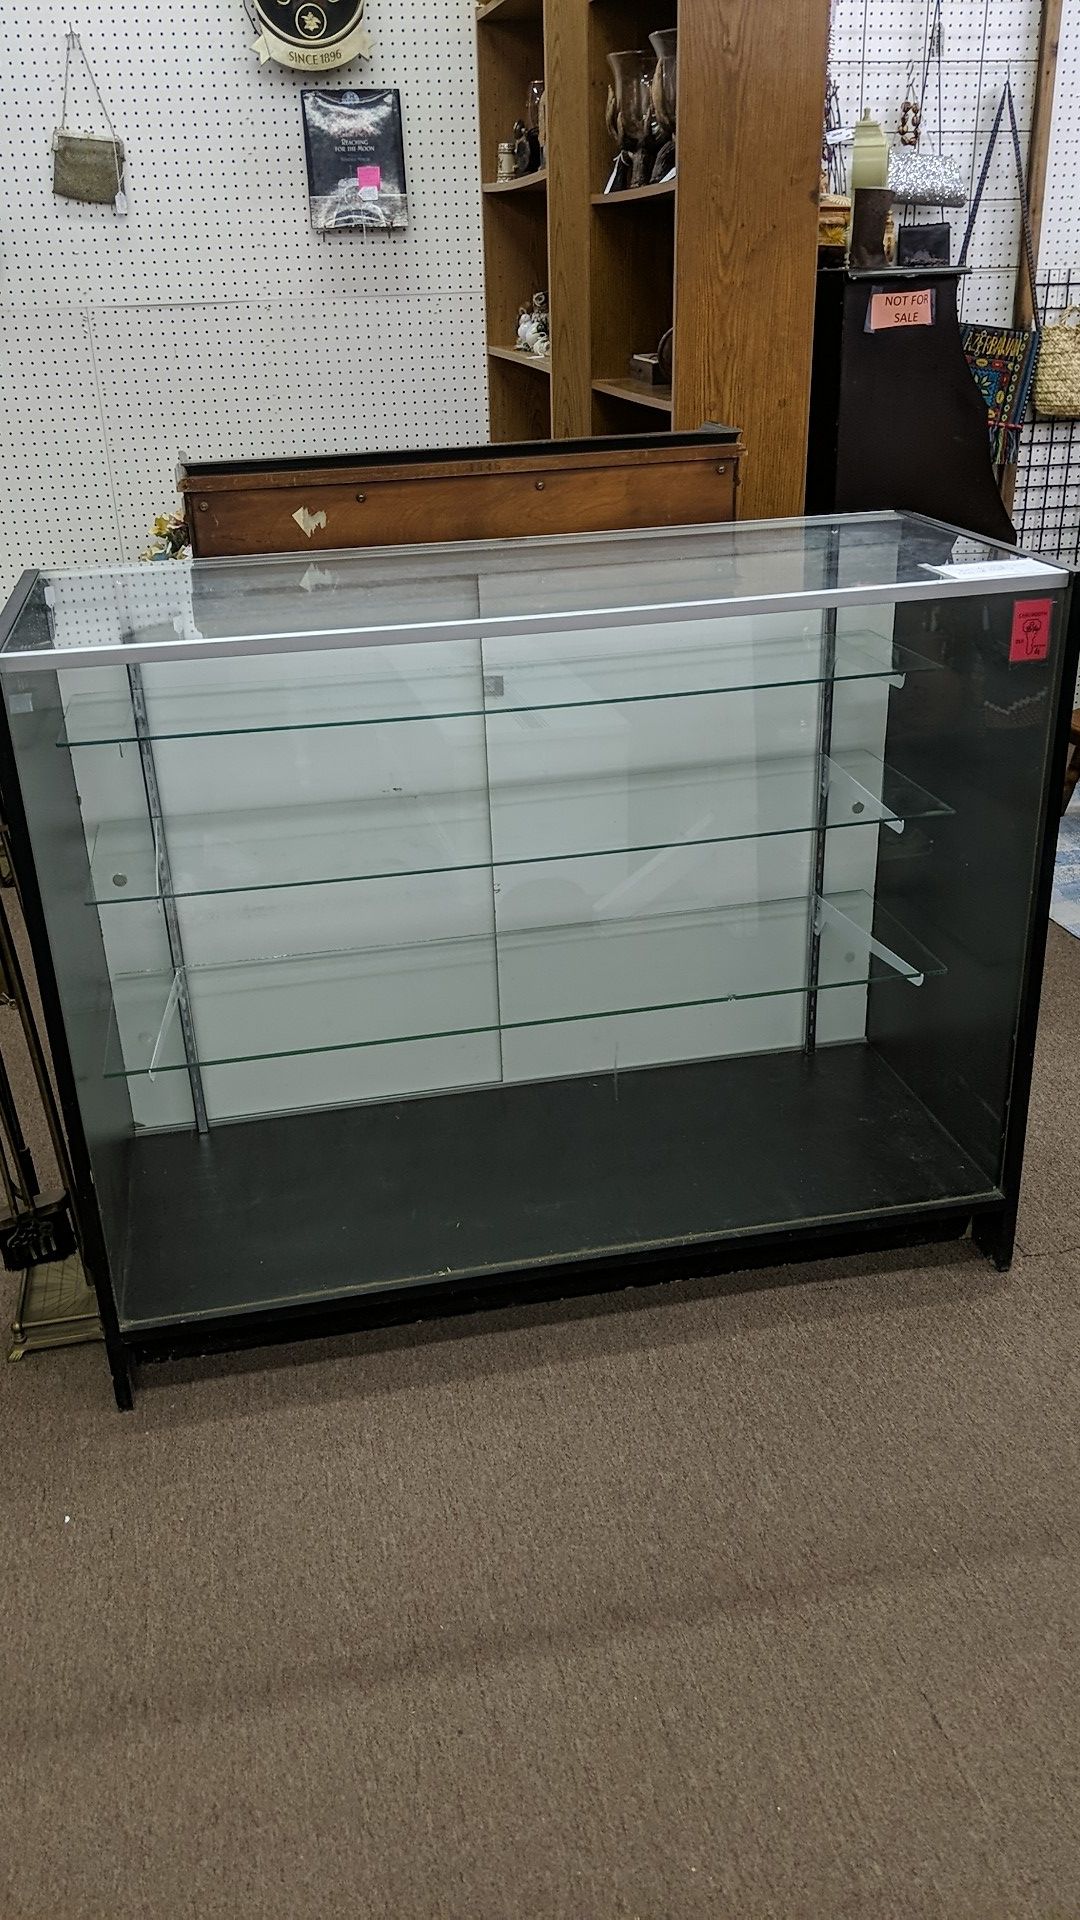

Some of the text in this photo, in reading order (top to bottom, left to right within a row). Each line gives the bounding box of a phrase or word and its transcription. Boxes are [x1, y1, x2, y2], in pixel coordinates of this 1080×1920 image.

[288, 49, 342, 65] SINCE 1896
[885, 294, 929, 306] NOT FOR
[894, 312, 919, 323] SALE
